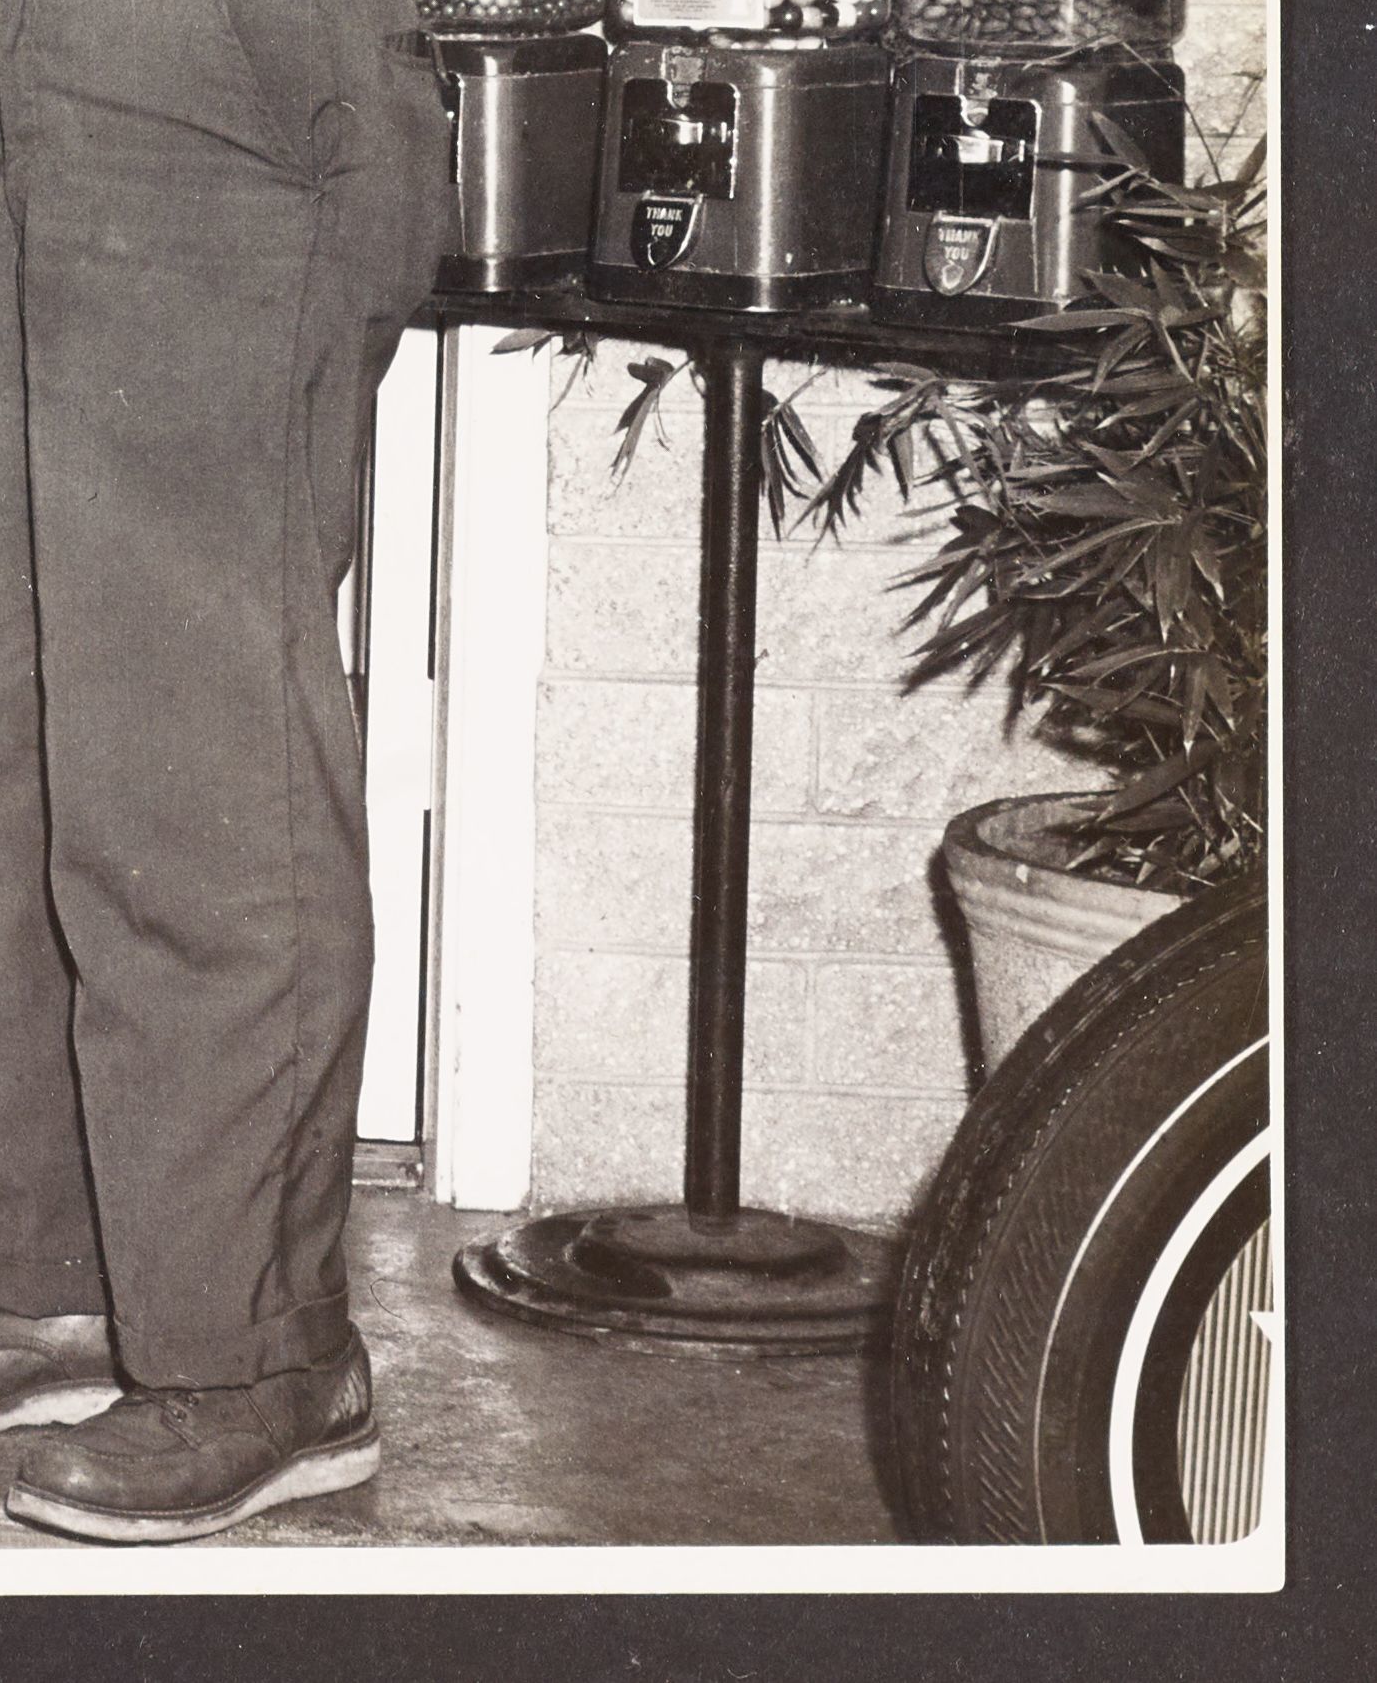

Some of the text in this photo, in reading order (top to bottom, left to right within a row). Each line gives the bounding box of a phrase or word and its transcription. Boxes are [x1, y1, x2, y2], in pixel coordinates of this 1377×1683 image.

[647, 207, 682, 222] THANK
[651, 225, 673, 238] YOU
[939, 229, 978, 243] THANK
[945, 247, 969, 260] YOU
